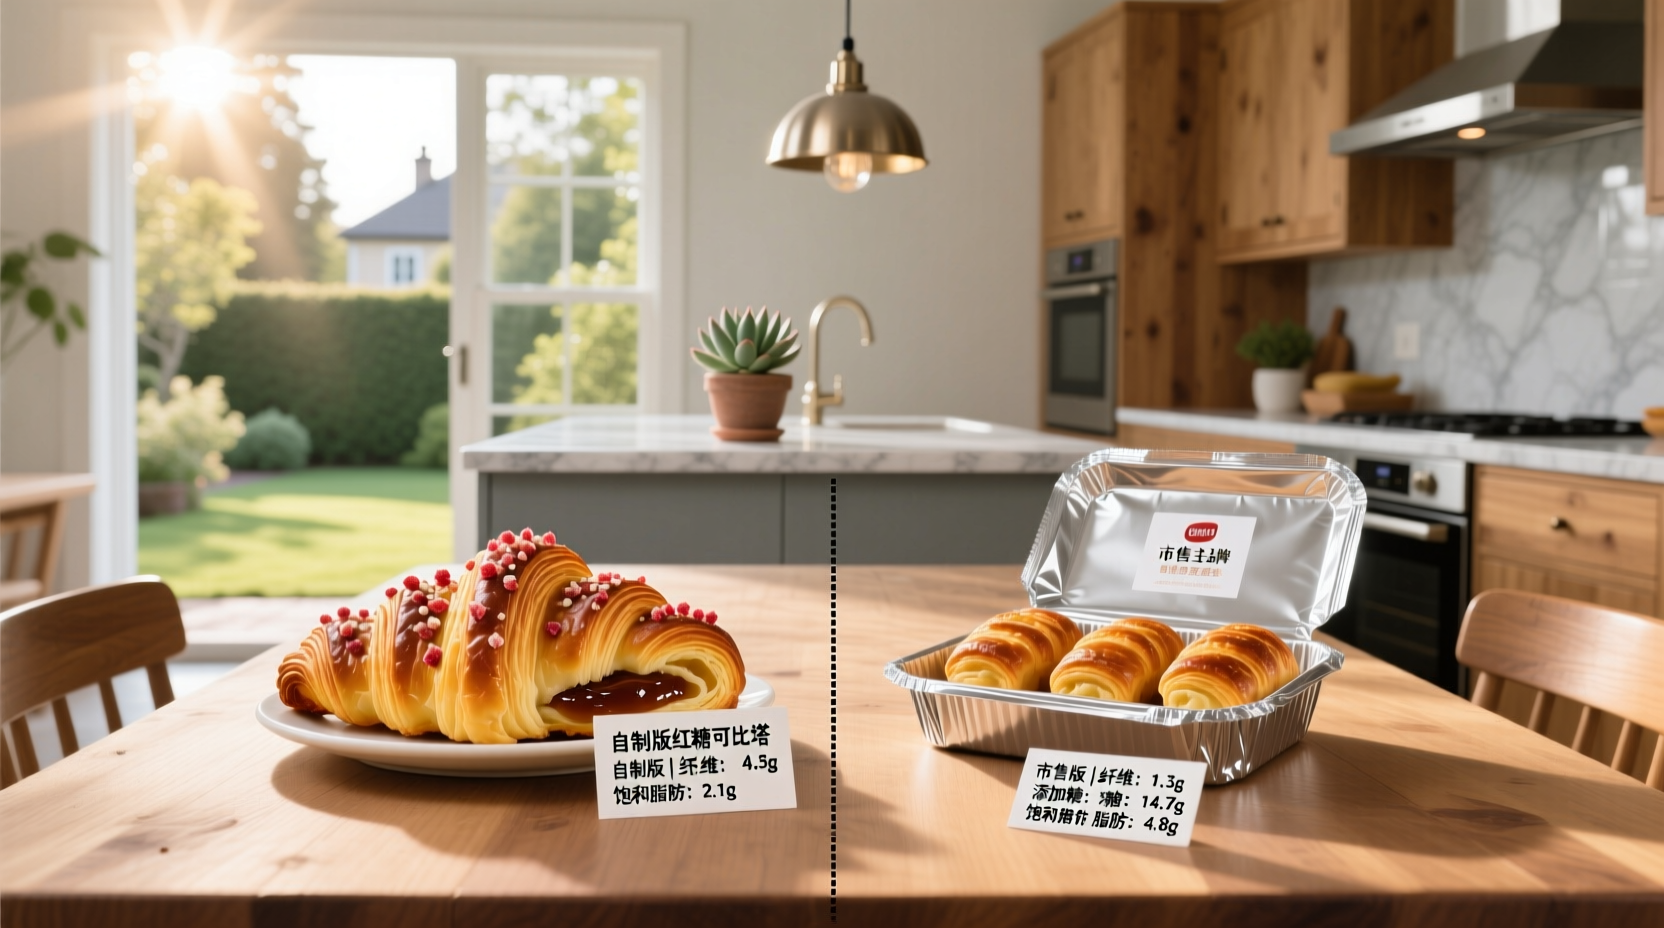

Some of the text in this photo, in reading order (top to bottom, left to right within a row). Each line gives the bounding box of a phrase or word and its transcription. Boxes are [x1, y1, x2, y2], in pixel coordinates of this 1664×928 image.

[612, 722, 771, 754] 自制版红糖可比塔
[741, 754, 778, 773] 4.5g
[702, 783, 737, 801] 2.1g
[1152, 773, 1185, 794] 1.3g
[1142, 795, 1185, 816] 14.7g
[1143, 816, 1179, 837] 4.8g
